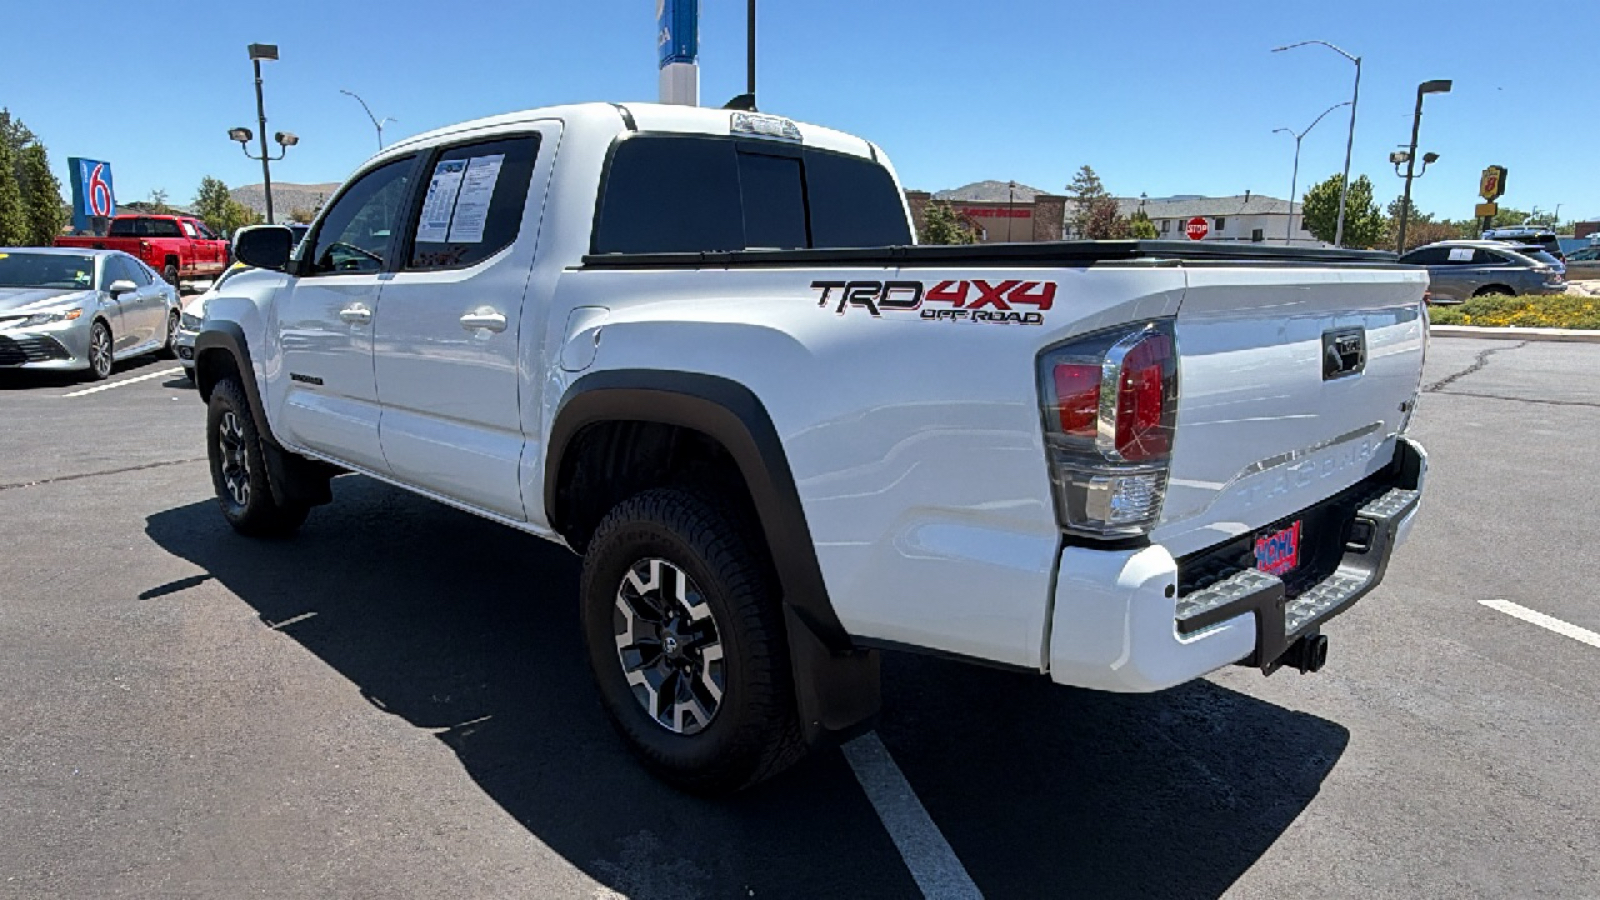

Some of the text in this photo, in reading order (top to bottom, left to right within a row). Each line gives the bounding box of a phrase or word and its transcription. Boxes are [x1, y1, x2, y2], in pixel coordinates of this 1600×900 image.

[90, 163, 112, 217] 6
[1187, 224, 1207, 234] STOP
[809, 279, 1058, 318] TRD 4X4
[919, 309, 1045, 325] OFF ROAD
[1254, 529, 1296, 570] HOHL
